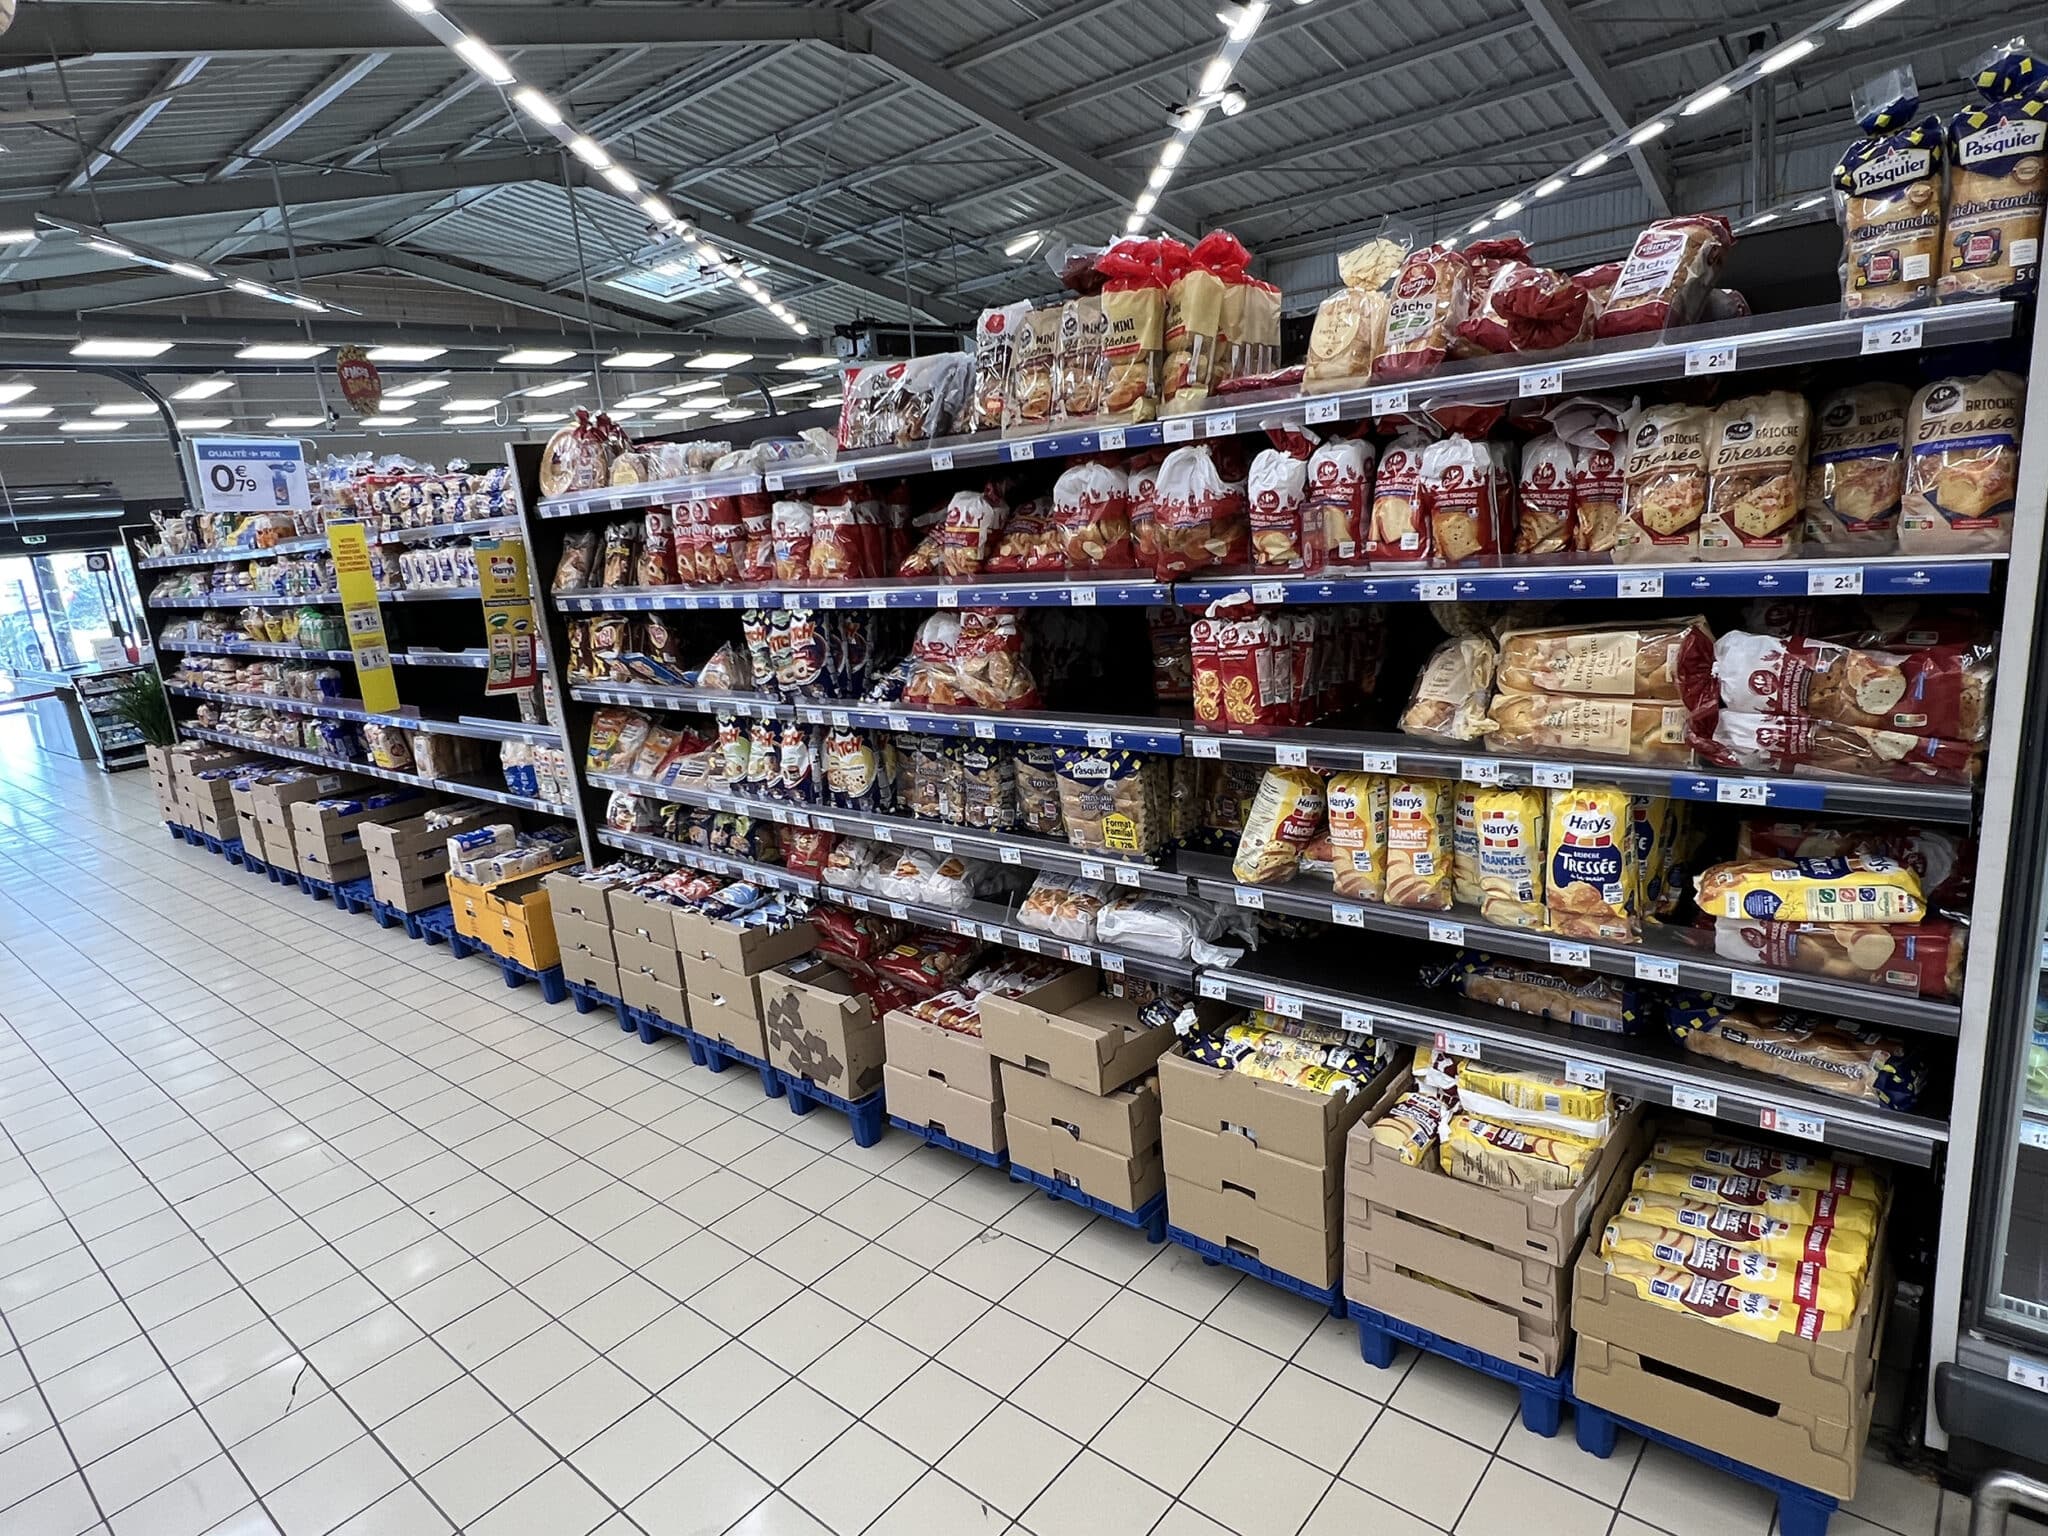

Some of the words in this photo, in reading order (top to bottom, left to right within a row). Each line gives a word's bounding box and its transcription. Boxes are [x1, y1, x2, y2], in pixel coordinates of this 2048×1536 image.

[1965, 132, 2040, 158] Pasquier
[1858, 158, 1926, 189] Pasquier
[1113, 318, 1135, 332] MINI
[1965, 398, 2015, 411] BRIOCHE
[1918, 415, 2017, 440] Tressée
[1629, 447, 1701, 473] Tressée
[1717, 441, 1797, 465] Tressée
[1074, 765, 1108, 776] Pasquier
[1105, 818, 1131, 828] Format
[1558, 851, 1617, 875] TRESSÉE
